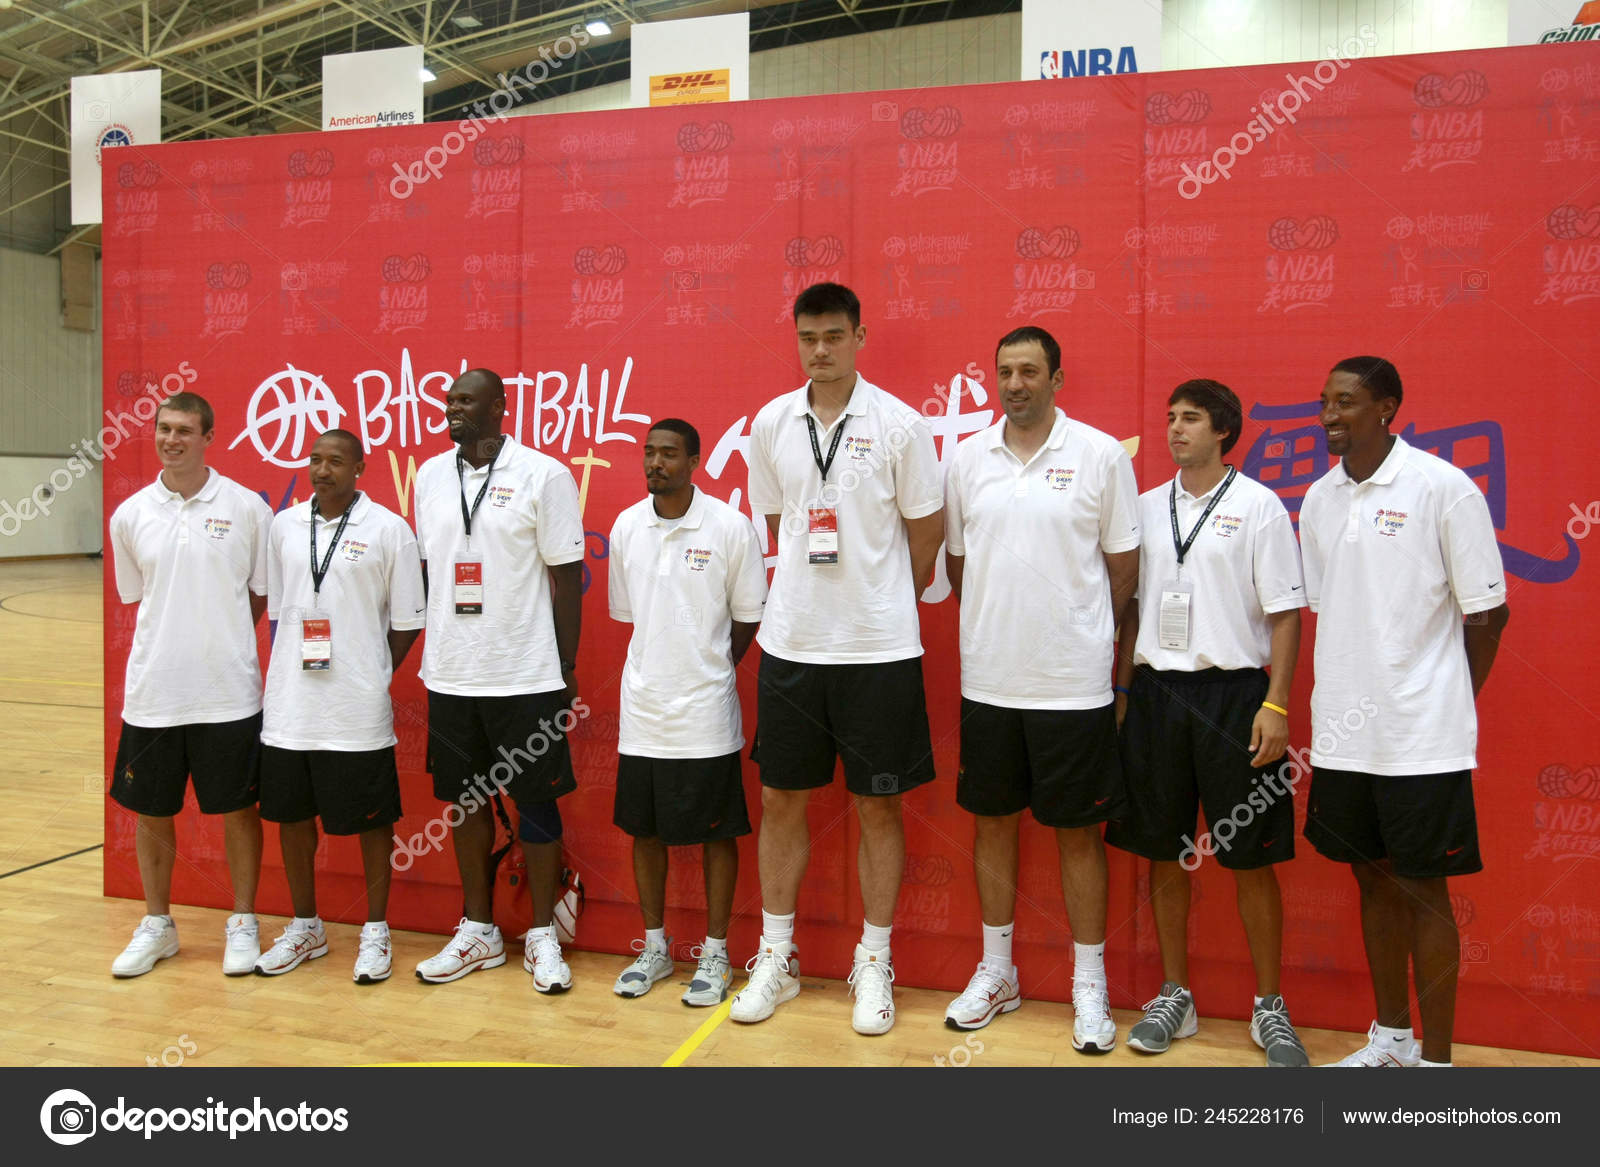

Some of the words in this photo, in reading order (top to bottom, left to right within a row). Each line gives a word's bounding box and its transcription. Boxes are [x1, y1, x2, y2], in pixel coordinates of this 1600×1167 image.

[1062, 46, 1138, 78] NBA
[663, 73, 716, 90] DHL
[1426, 110, 1483, 139] NBA
[1280, 254, 1335, 282] NBA
[352, 347, 652, 455] BASTBALL
